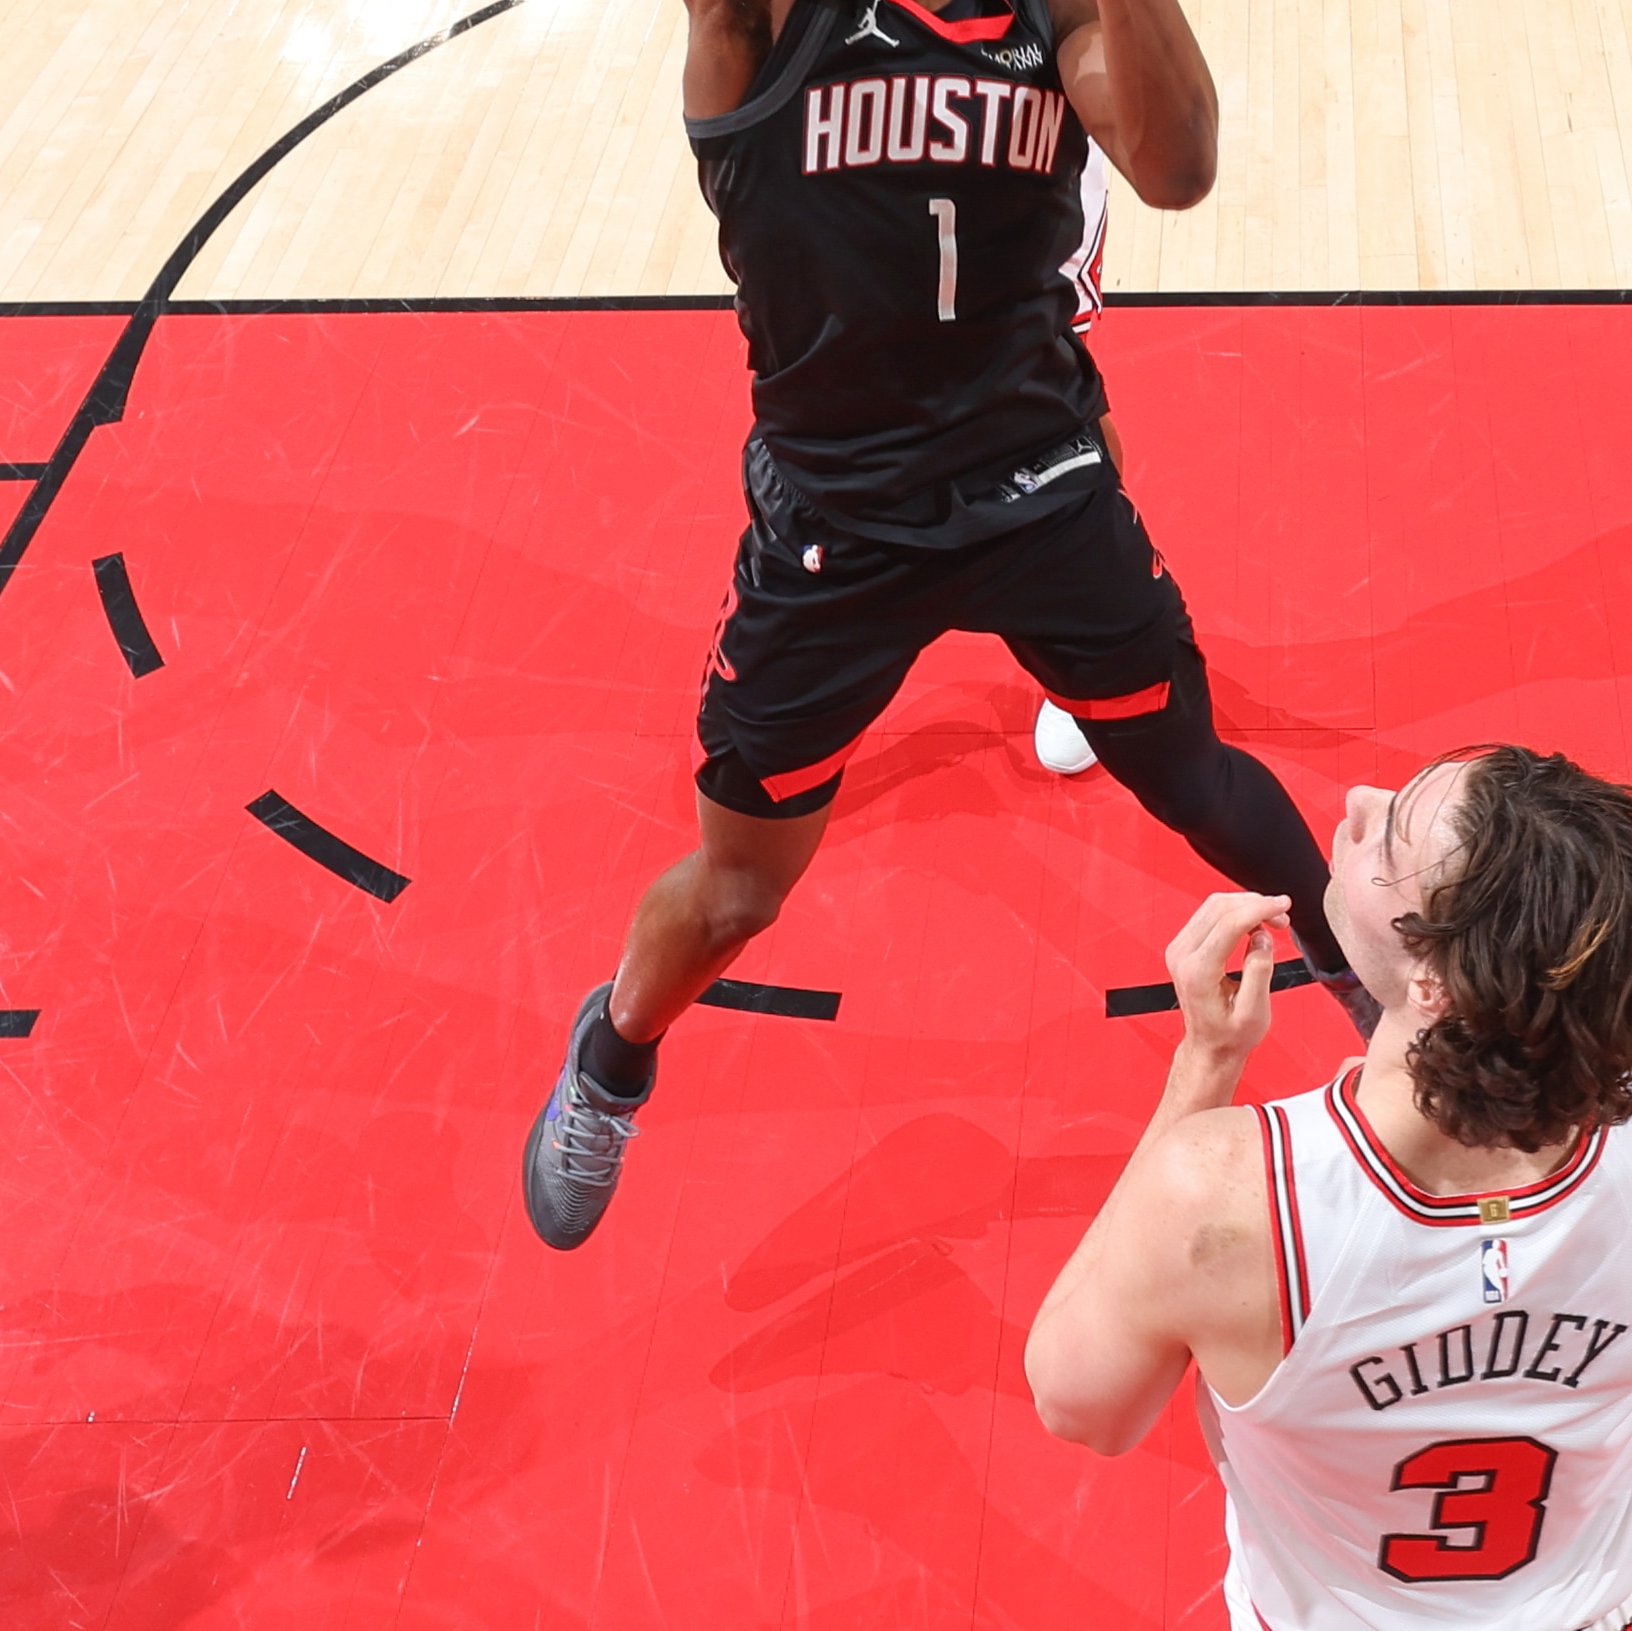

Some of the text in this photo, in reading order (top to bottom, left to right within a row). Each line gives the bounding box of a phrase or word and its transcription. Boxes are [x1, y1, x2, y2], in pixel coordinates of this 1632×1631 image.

[802, 75, 1064, 176] HOUSTON
[928, 198, 958, 322] 1
[1349, 1309, 1628, 1411] GIDDEY
[1378, 1435, 1559, 1583] 3
